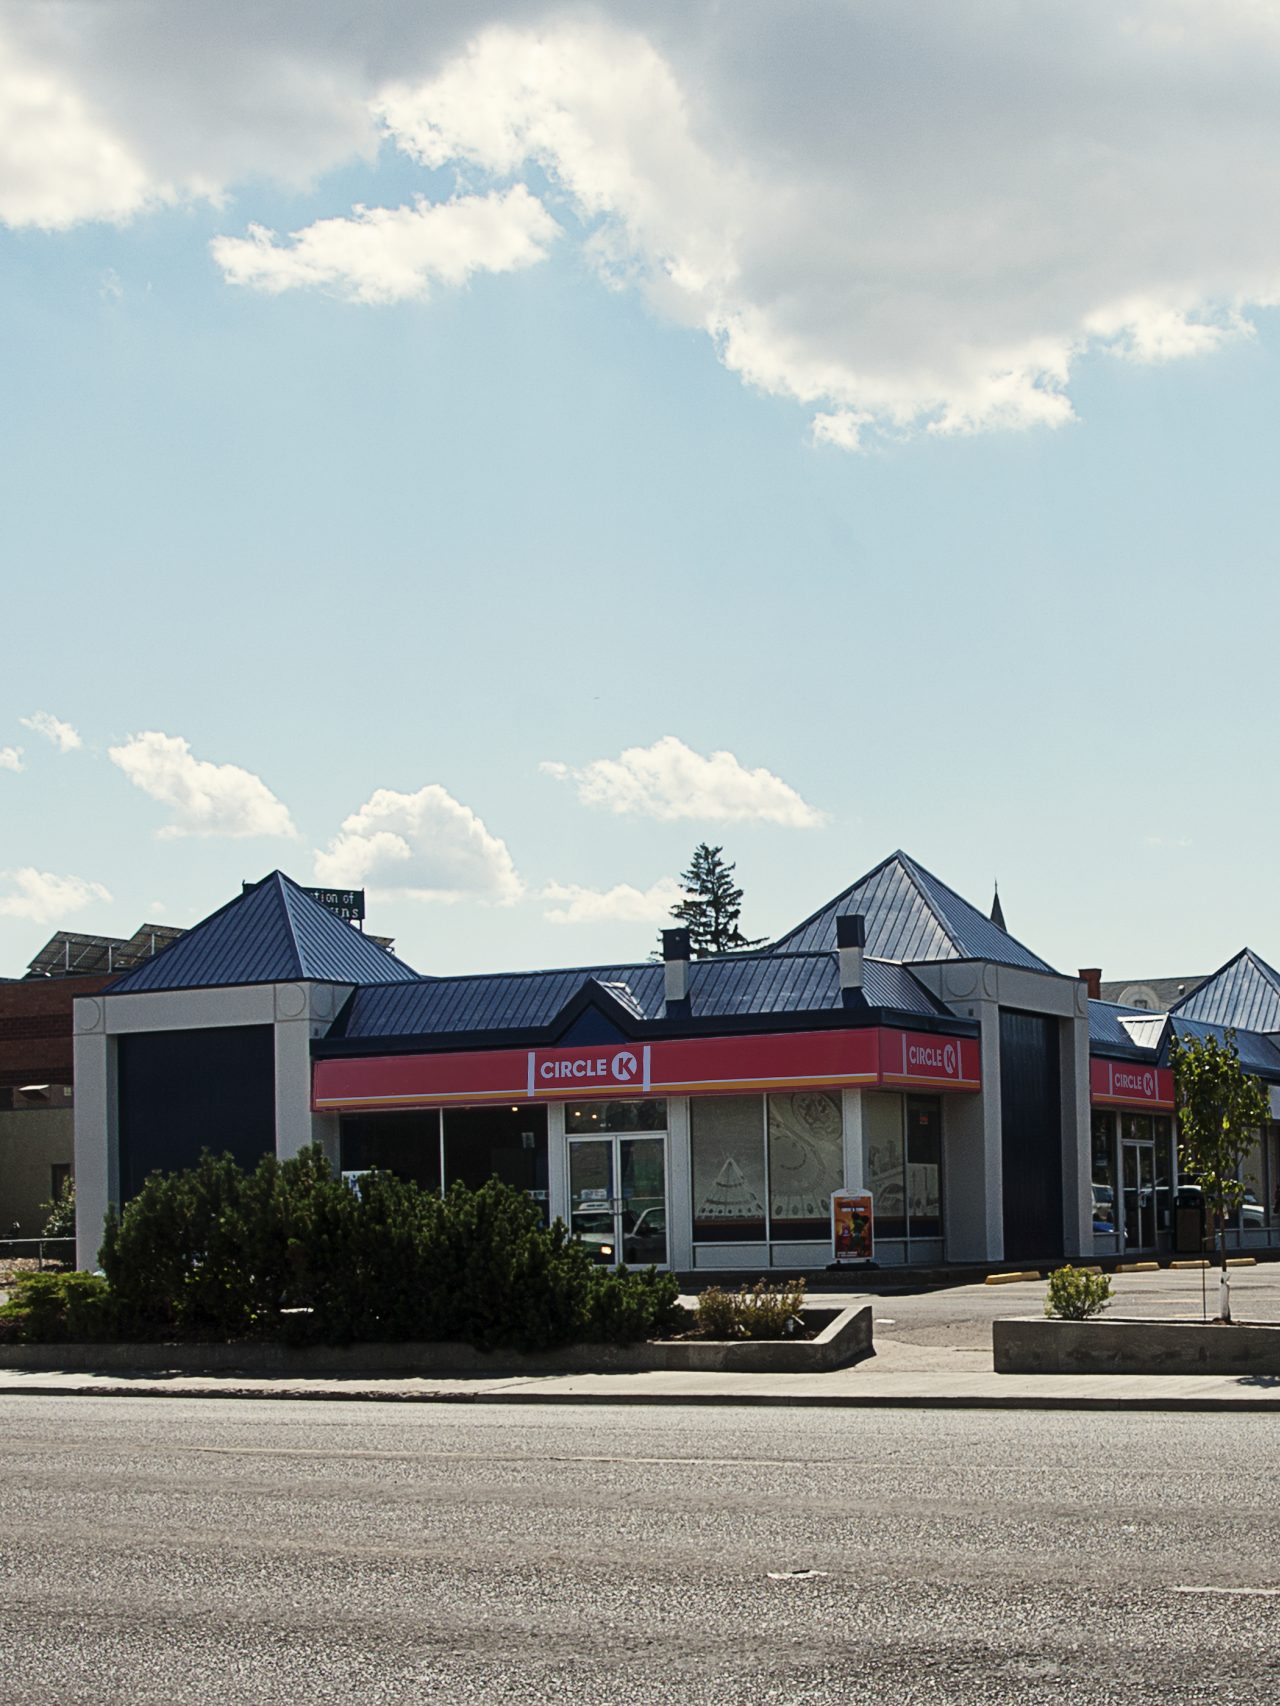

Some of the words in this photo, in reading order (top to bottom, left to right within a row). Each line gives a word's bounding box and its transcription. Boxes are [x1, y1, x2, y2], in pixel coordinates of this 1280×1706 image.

[342, 892, 354, 904] of
[540, 1058, 607, 1079] CIRCLE
[613, 1054, 637, 1080] K
[909, 1045, 942, 1067] CIRCLE
[944, 1046, 956, 1073] K
[1114, 1072, 1142, 1090] CIRCLE
[1143, 1074, 1153, 1095] K
